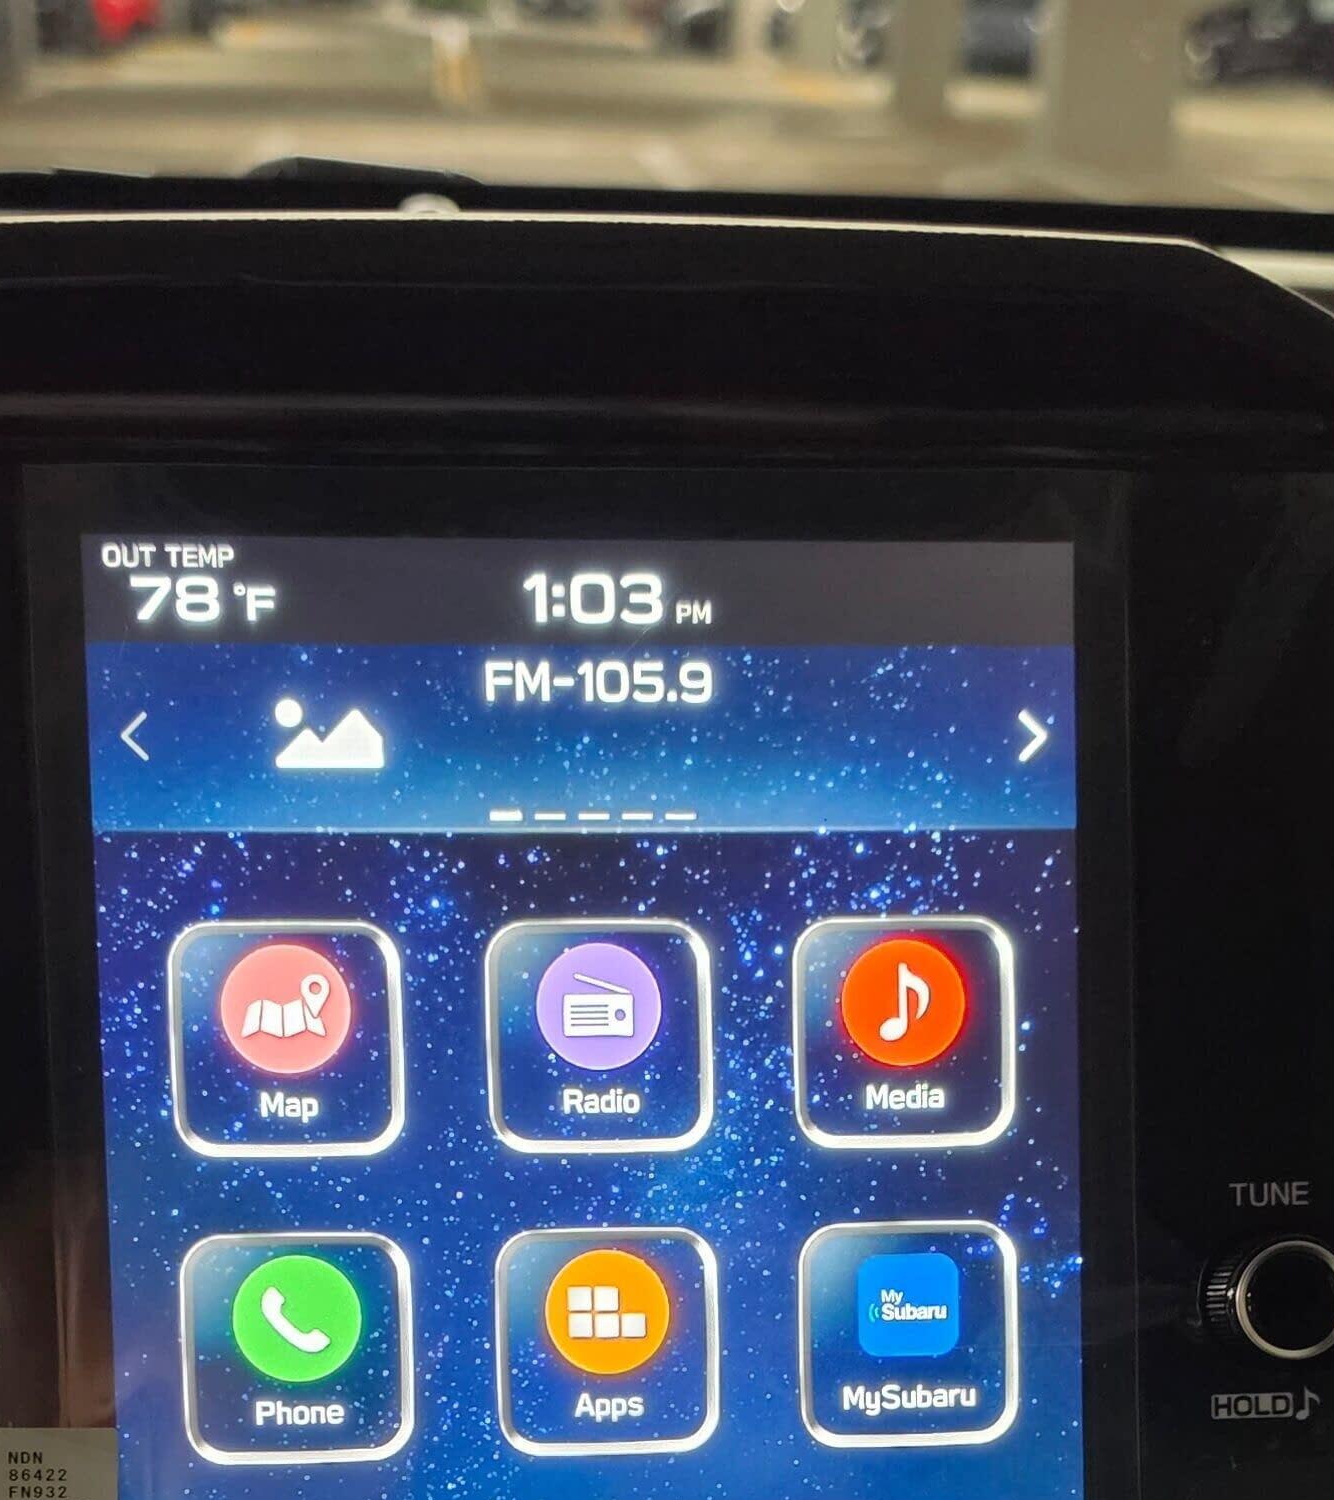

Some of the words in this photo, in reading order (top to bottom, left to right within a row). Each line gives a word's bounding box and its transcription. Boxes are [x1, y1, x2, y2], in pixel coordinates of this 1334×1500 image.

[101, 543, 156, 568] OUT
[164, 543, 235, 568] TEMP
[129, 575, 220, 622] 78
[523, 572, 663, 625] 1:03
[675, 599, 712, 625] PM
[484, 660, 713, 704] FM-105.9
[260, 1091, 319, 1124] Map
[562, 1088, 640, 1115] Radio
[865, 1083, 945, 1110] Media
[1228, 1181, 1310, 1207] TUNE
[880, 1288, 904, 1305] My
[881, 1302, 948, 1321] Subaru
[255, 1400, 345, 1426] Phone
[574, 1392, 645, 1423] Apps
[842, 1384, 977, 1416] MySubaru
[1212, 1394, 1291, 1418] HOLD
[8, 1451, 44, 1465] NDN
[9, 1469, 68, 1482] 86422
[8, 1486, 68, 1499] FN932
